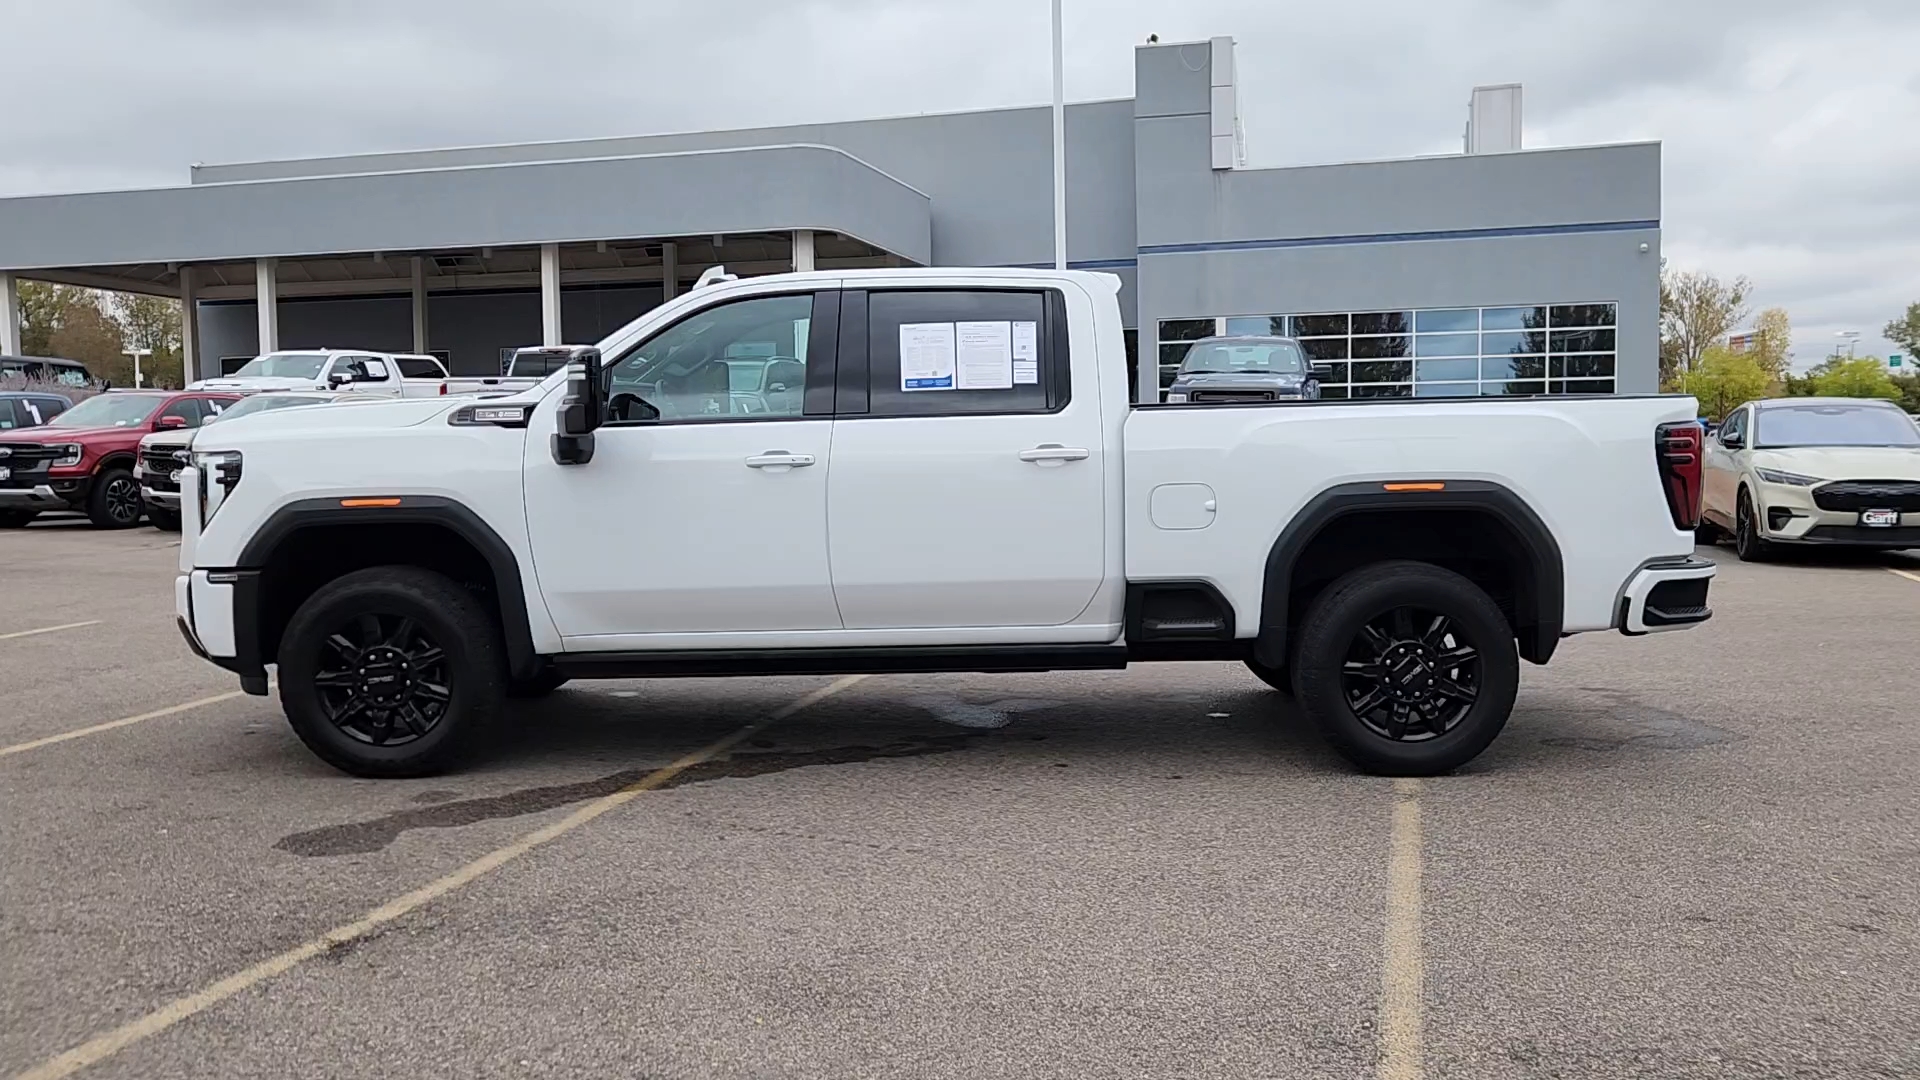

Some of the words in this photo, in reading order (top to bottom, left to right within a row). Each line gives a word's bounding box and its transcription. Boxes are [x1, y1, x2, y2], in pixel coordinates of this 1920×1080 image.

[1862, 511, 1898, 524] Garff
[368, 675, 394, 684] GMC
[1401, 664, 1423, 685] GMC
